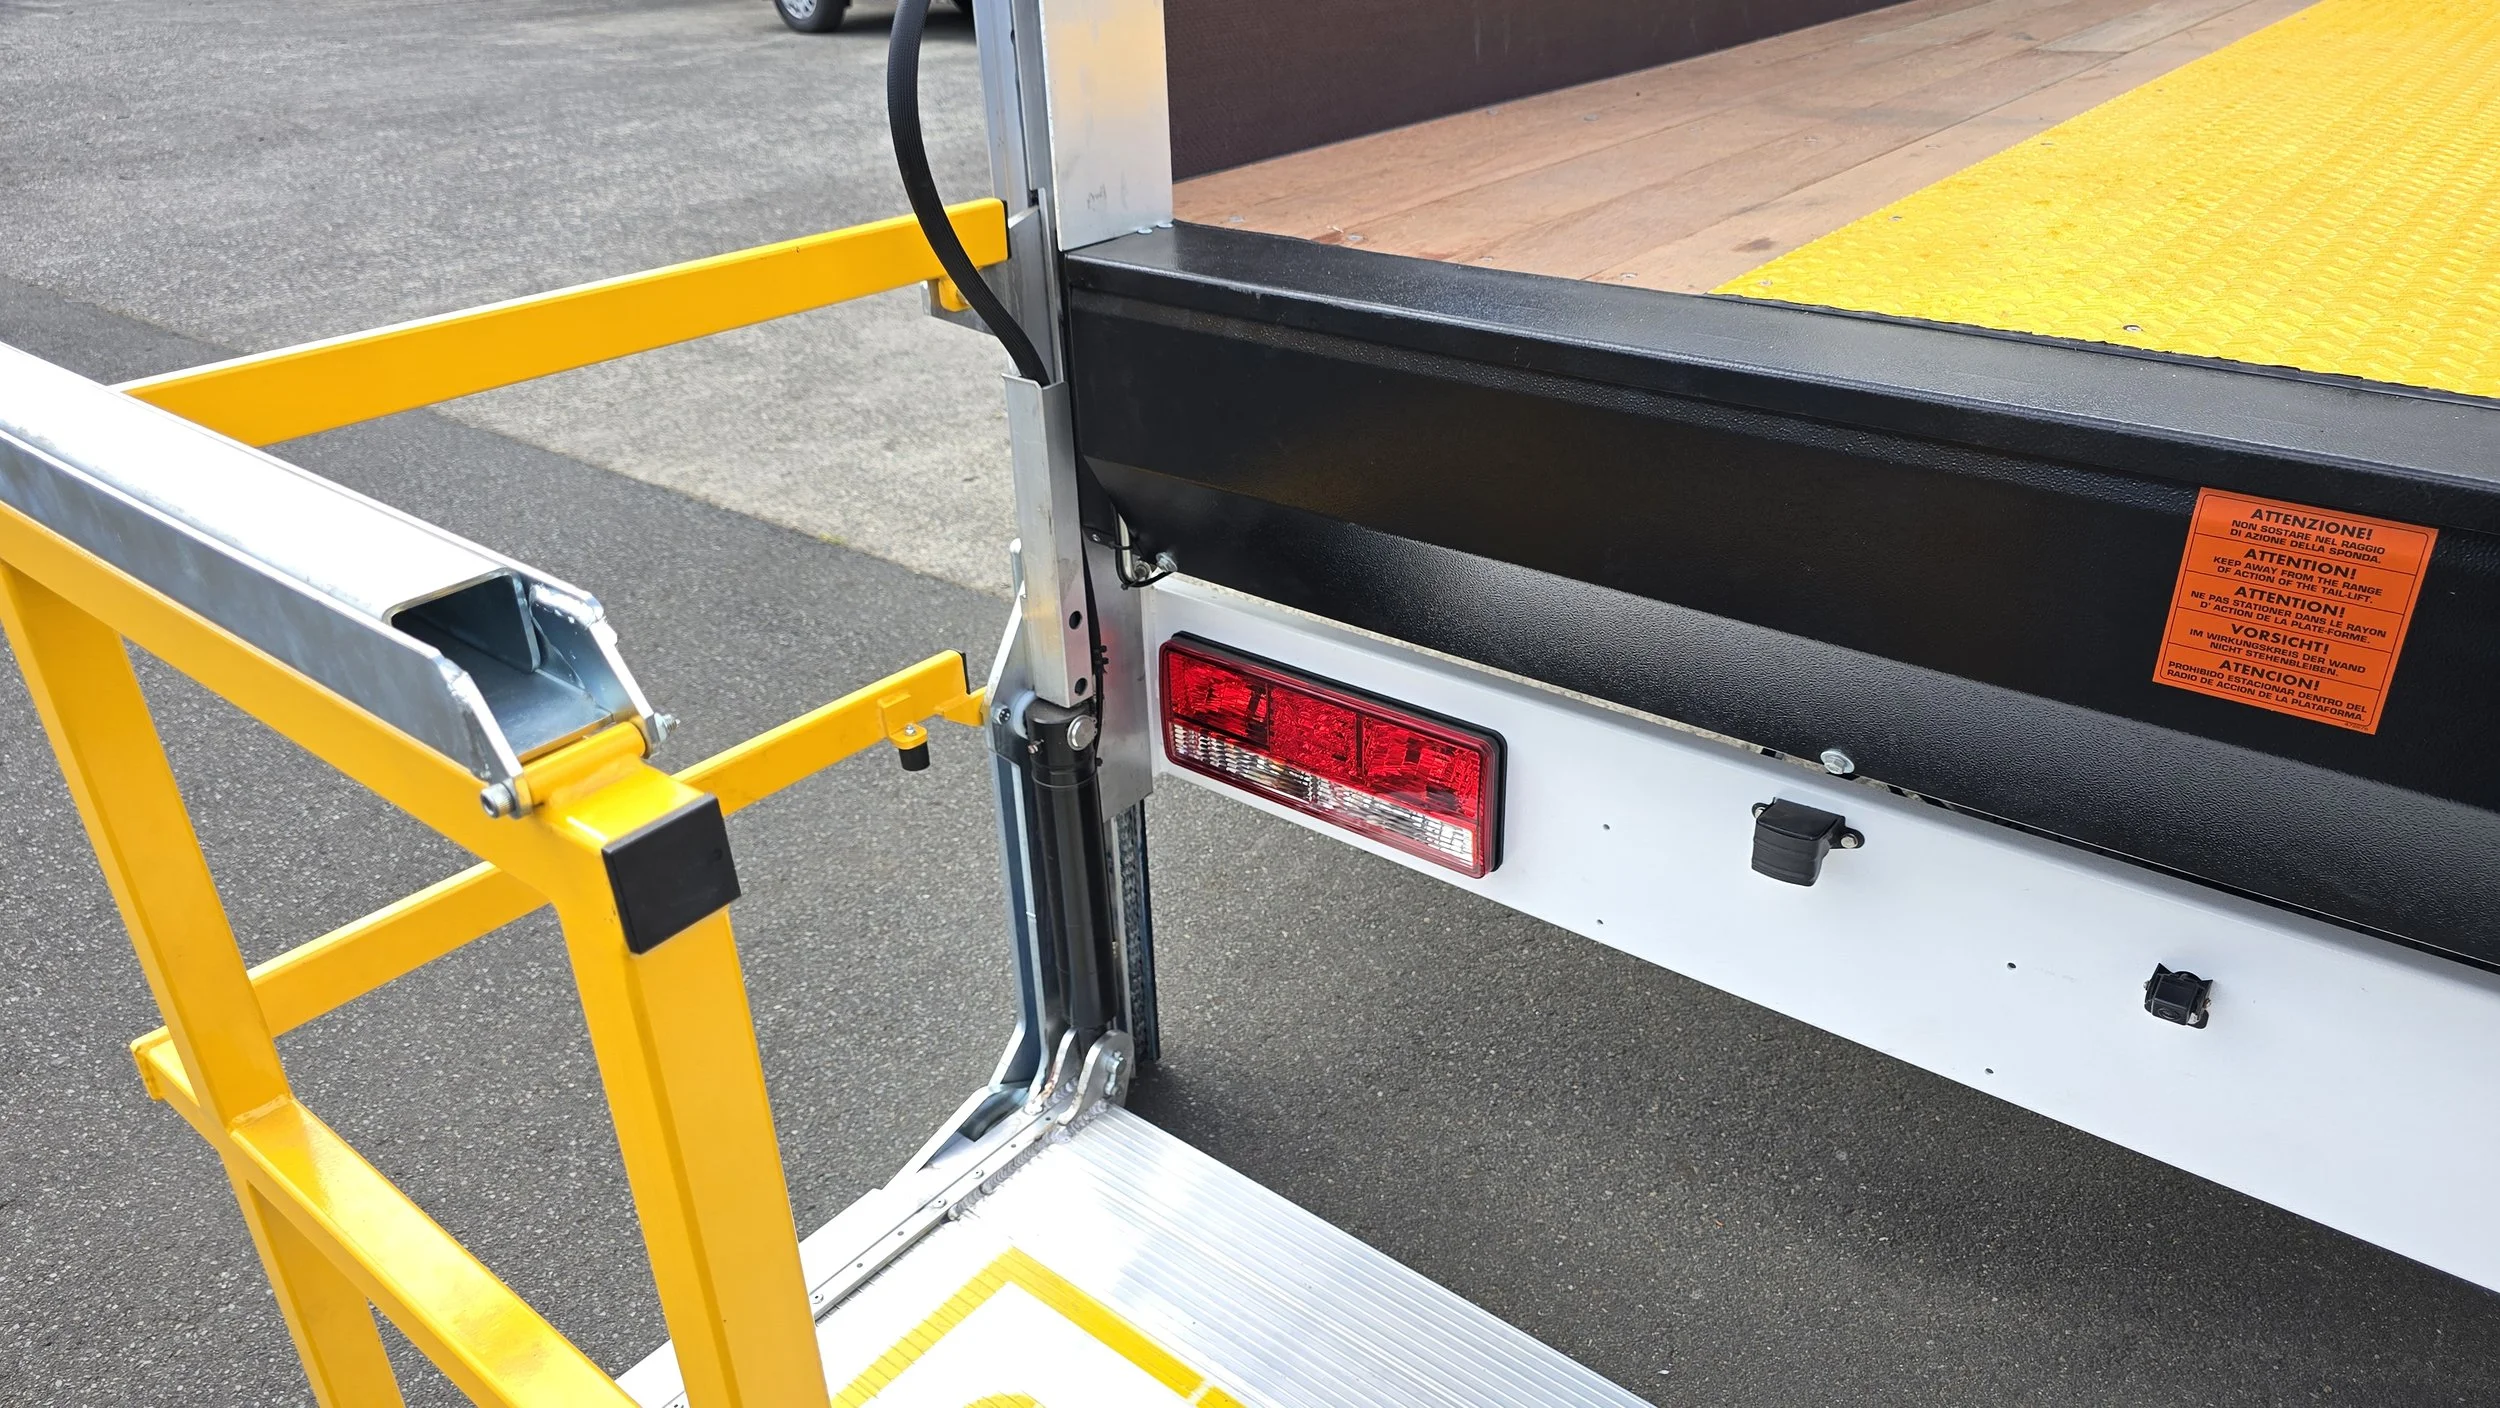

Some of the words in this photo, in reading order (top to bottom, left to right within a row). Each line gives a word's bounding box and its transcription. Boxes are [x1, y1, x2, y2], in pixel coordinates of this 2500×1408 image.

[2231, 519, 2258, 532] NON
[2259, 524, 2312, 542] SOSTARE
[2314, 534, 2338, 547] NEL
[2340, 539, 2386, 556] RAGGIO
[2249, 508, 2374, 541] ATTENZIONE!
[2229, 528, 2243, 537] DI
[2243, 531, 2288, 546] AZIONE
[2289, 539, 2326, 554] DELLA
[2328, 547, 2382, 564] SPONDA.
[2243, 548, 2357, 580] ATTENTION!
[2212, 555, 2242, 568] KEEP
[2243, 562, 2279, 575] AWAY
[2280, 568, 2315, 583] FROM
[2317, 575, 2340, 588] THE
[2341, 581, 2383, 597] RANGE
[2216, 565, 2232, 574] OF
[2233, 568, 2276, 584] ACTION
[2277, 577, 2294, 587] OF
[2296, 580, 2318, 593] THE
[2321, 586, 2373, 604] TAIL-LIFT.
[2190, 590, 2206, 600] NE
[2208, 593, 2231, 605] PAS
[2232, 599, 2293, 618] STATIONER
[2294, 612, 2328, 626] DANS
[2329, 619, 2344, 629] LE
[2345, 622, 2387, 639] RAYON
[2233, 585, 2346, 619] ATTENTION!
[2212, 603, 2254, 619] ACTION
[2255, 612, 2272, 623] DE
[2273, 616, 2288, 626] LA
[2290, 619, 2371, 644] PLATE-FORME.
[2230, 623, 2330, 655] VORSICHT!
[2189, 628, 2204, 638] IM
[2206, 631, 2300, 659] WIRKUNGSKREIS
[2301, 652, 2326, 665] DER
[2328, 658, 2367, 674] WAND
[2209, 641, 2244, 655] NICHT
[2244, 649, 2339, 677] STEHENBLEIBEN.
[2167, 660, 2225, 680] PROHIBIDO
[2226, 674, 2296, 697] ESTACIONAR
[2297, 690, 2344, 708] DENTRO
[2345, 702, 2368, 714] DEL
[2218, 659, 2321, 692] ATENCION!
[2166, 668, 2198, 682] RADIO
[2199, 676, 2215, 687] DE
[2215, 680, 2256, 696] ACCION
[2257, 690, 2273, 700] DE
[2274, 694, 2289, 704] LA
[2290, 697, 2365, 722] PLATAFORMA.
